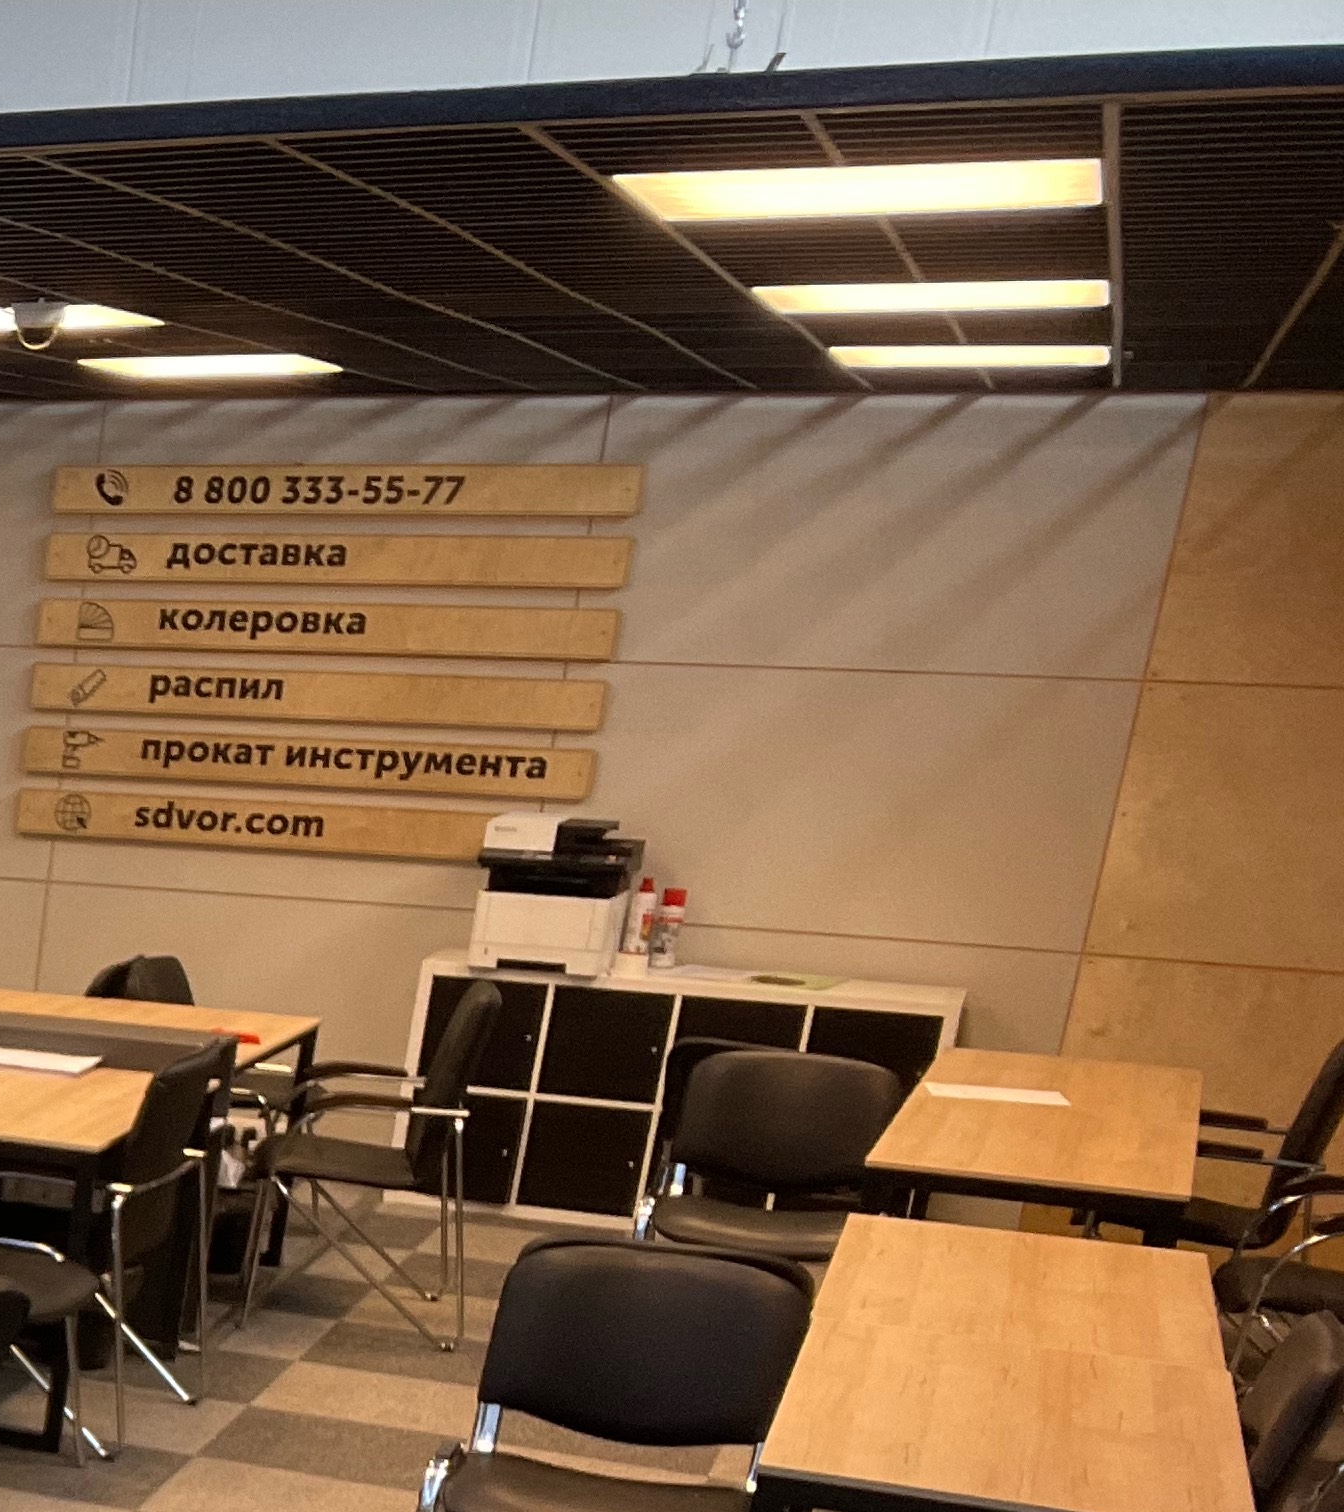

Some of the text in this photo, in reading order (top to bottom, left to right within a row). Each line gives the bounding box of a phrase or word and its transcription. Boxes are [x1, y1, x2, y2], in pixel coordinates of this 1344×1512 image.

[172, 474, 467, 506] 8 800 333-55-77
[164, 541, 348, 570] доставка
[158, 607, 368, 642] колеровка
[147, 671, 285, 705] распил
[139, 736, 549, 781] прокат инструмента
[133, 801, 325, 839] sdvor.com
